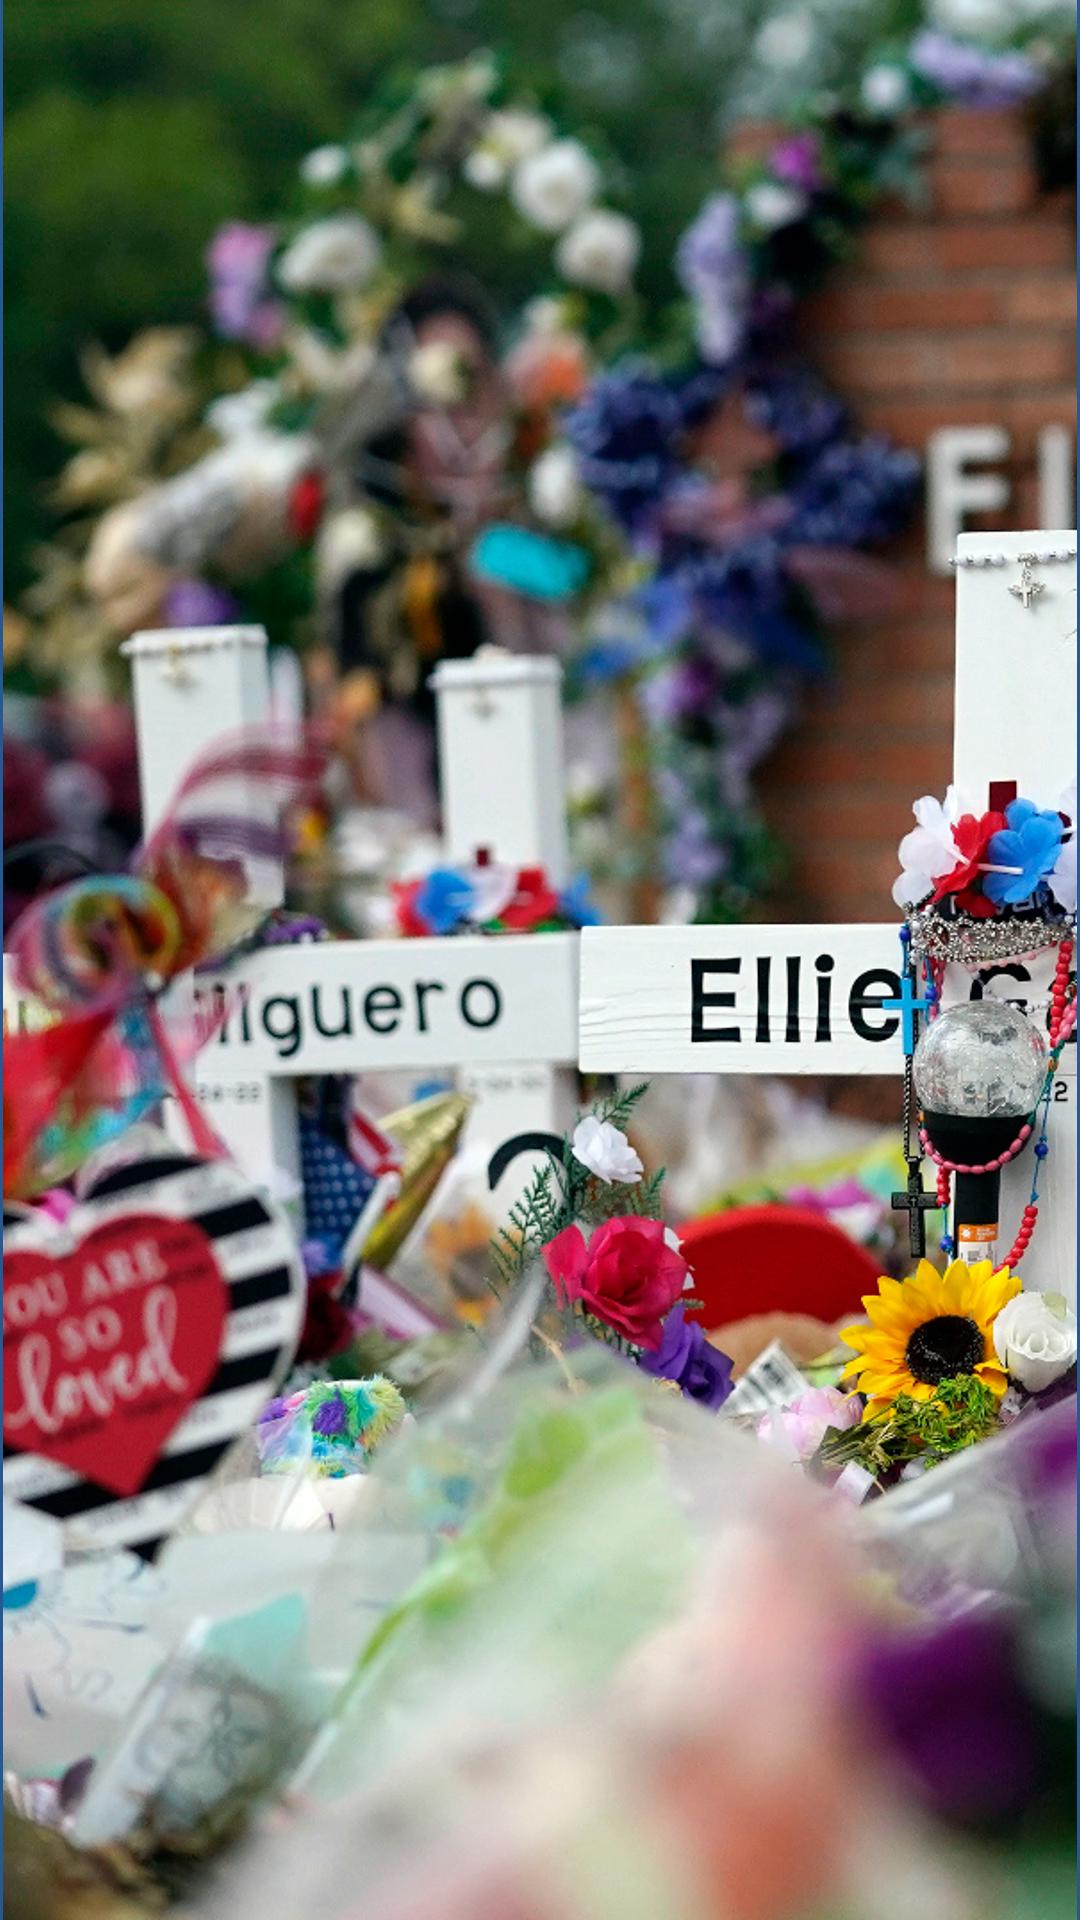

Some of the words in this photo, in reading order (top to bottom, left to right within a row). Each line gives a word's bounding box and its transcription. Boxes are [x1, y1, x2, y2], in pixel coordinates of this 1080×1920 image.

[690, 953, 903, 1043] Ellie
[81, 1237, 168, 1304] ARE
[4, 1283, 190, 1435] loved
[57, 1305, 122, 1362] SO
